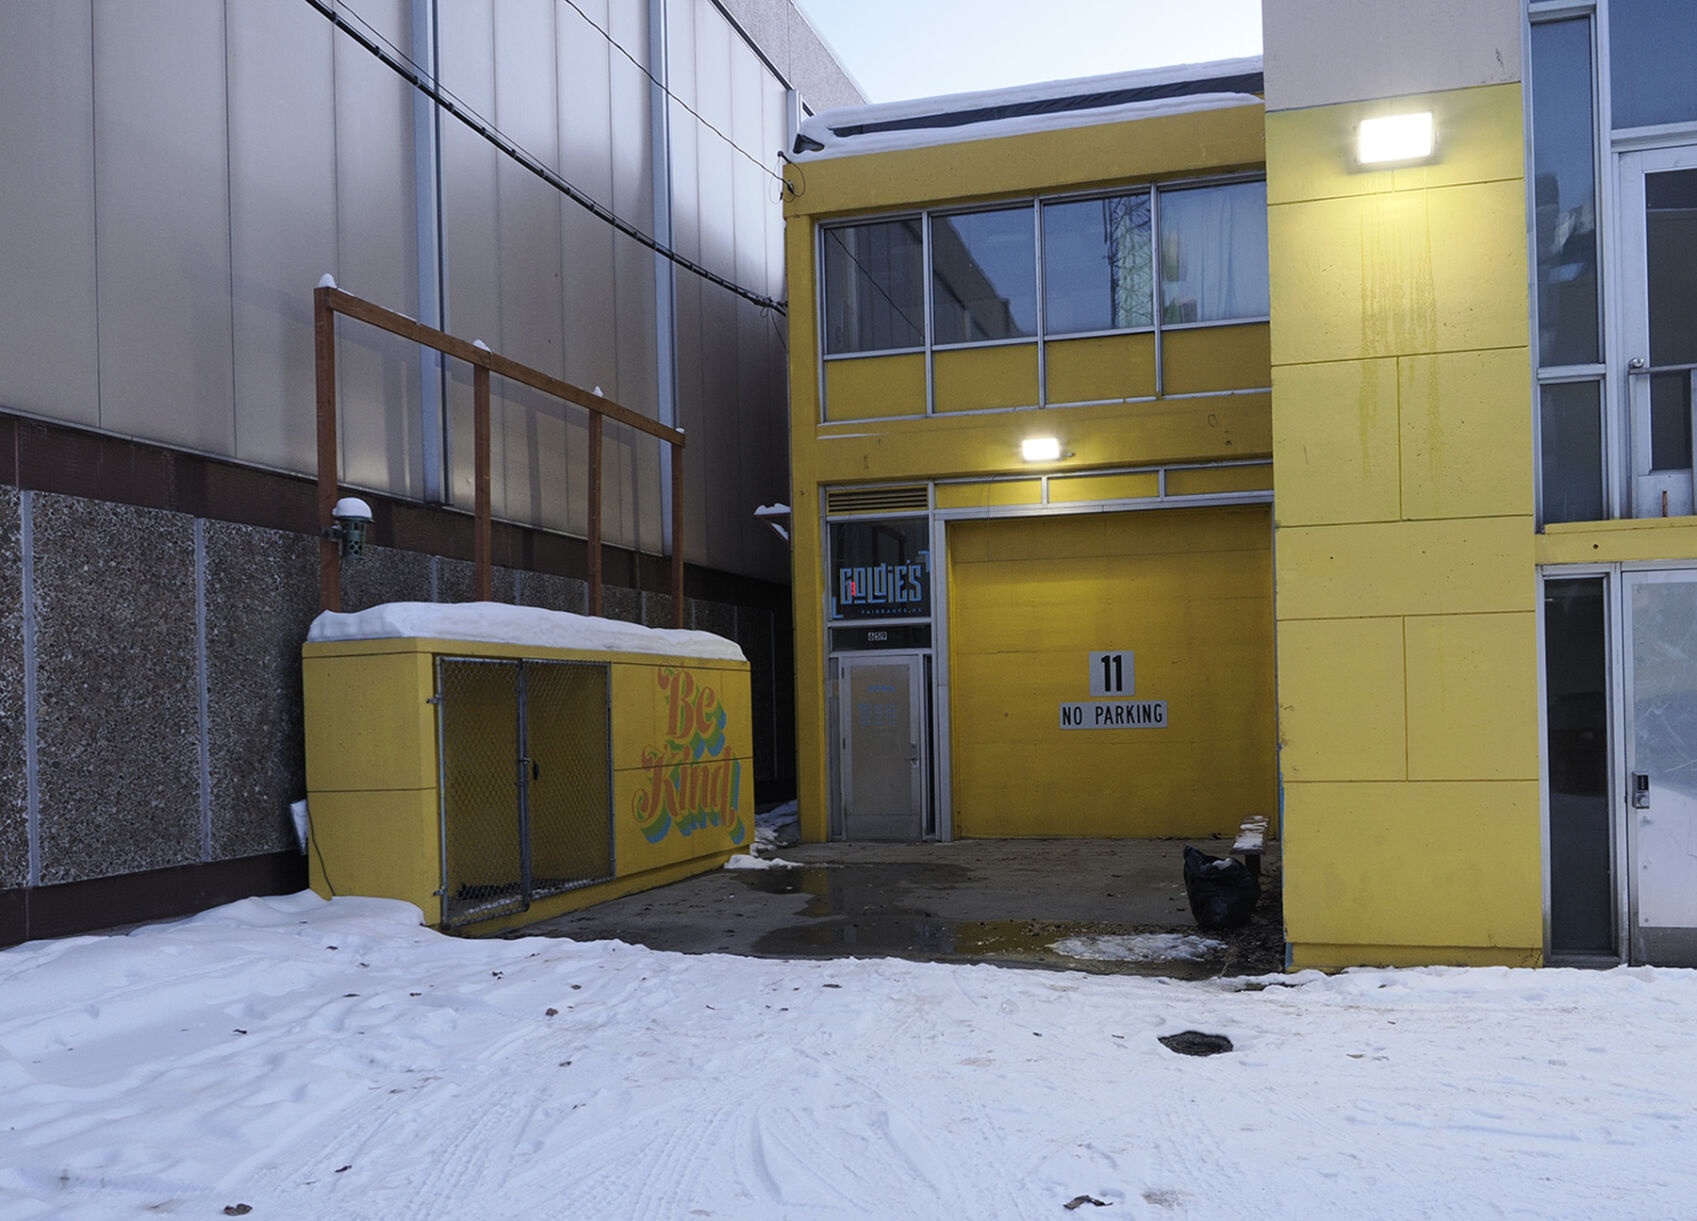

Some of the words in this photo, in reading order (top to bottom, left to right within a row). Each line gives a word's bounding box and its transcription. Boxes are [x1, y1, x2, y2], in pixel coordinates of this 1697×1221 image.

[657, 663, 720, 741] Be
[1101, 654, 1123, 692] 11
[1062, 706, 1083, 726] NO
[1095, 703, 1163, 725] PARKING
[632, 744, 740, 832] Kind
